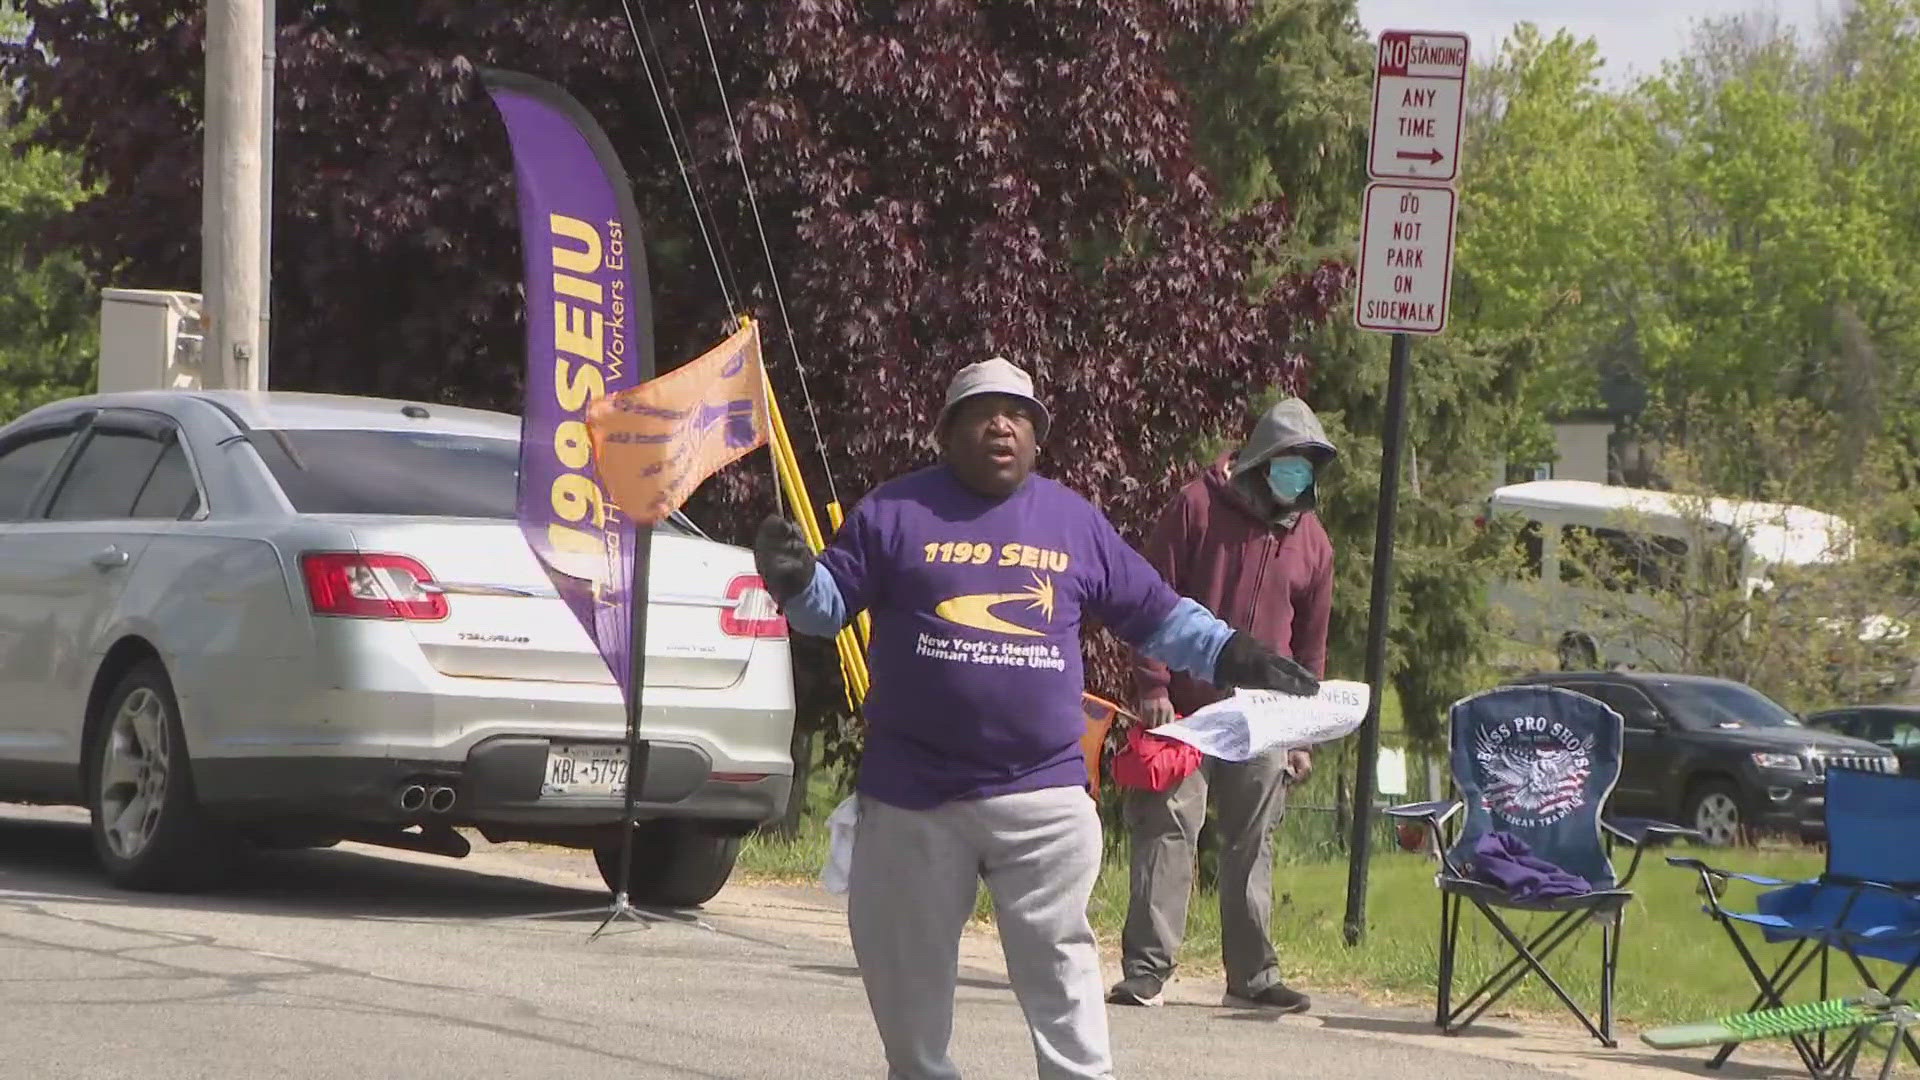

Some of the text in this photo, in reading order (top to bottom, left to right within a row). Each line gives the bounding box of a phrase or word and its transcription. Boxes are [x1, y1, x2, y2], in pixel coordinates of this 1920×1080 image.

[1382, 40, 1463, 68] NO STANDING
[1401, 88, 1436, 108] ANY
[1399, 117, 1436, 138] TIME
[1400, 195, 1419, 214] DO
[1393, 222, 1422, 241] NOT
[1386, 248, 1423, 269] PARK
[1394, 275, 1412, 294] ON
[604, 218, 625, 382] Workers East
[1367, 300, 1435, 322] SIDEWALK
[924, 542, 1070, 573] 1199 SEIU
[916, 645, 968, 663] Human
[971, 652, 1025, 667] Service
[918, 632, 1060, 658] New York's Health &
[1477, 716, 1590, 769] BASS PRO SHOPS
[552, 759, 629, 785] KBL 5792
